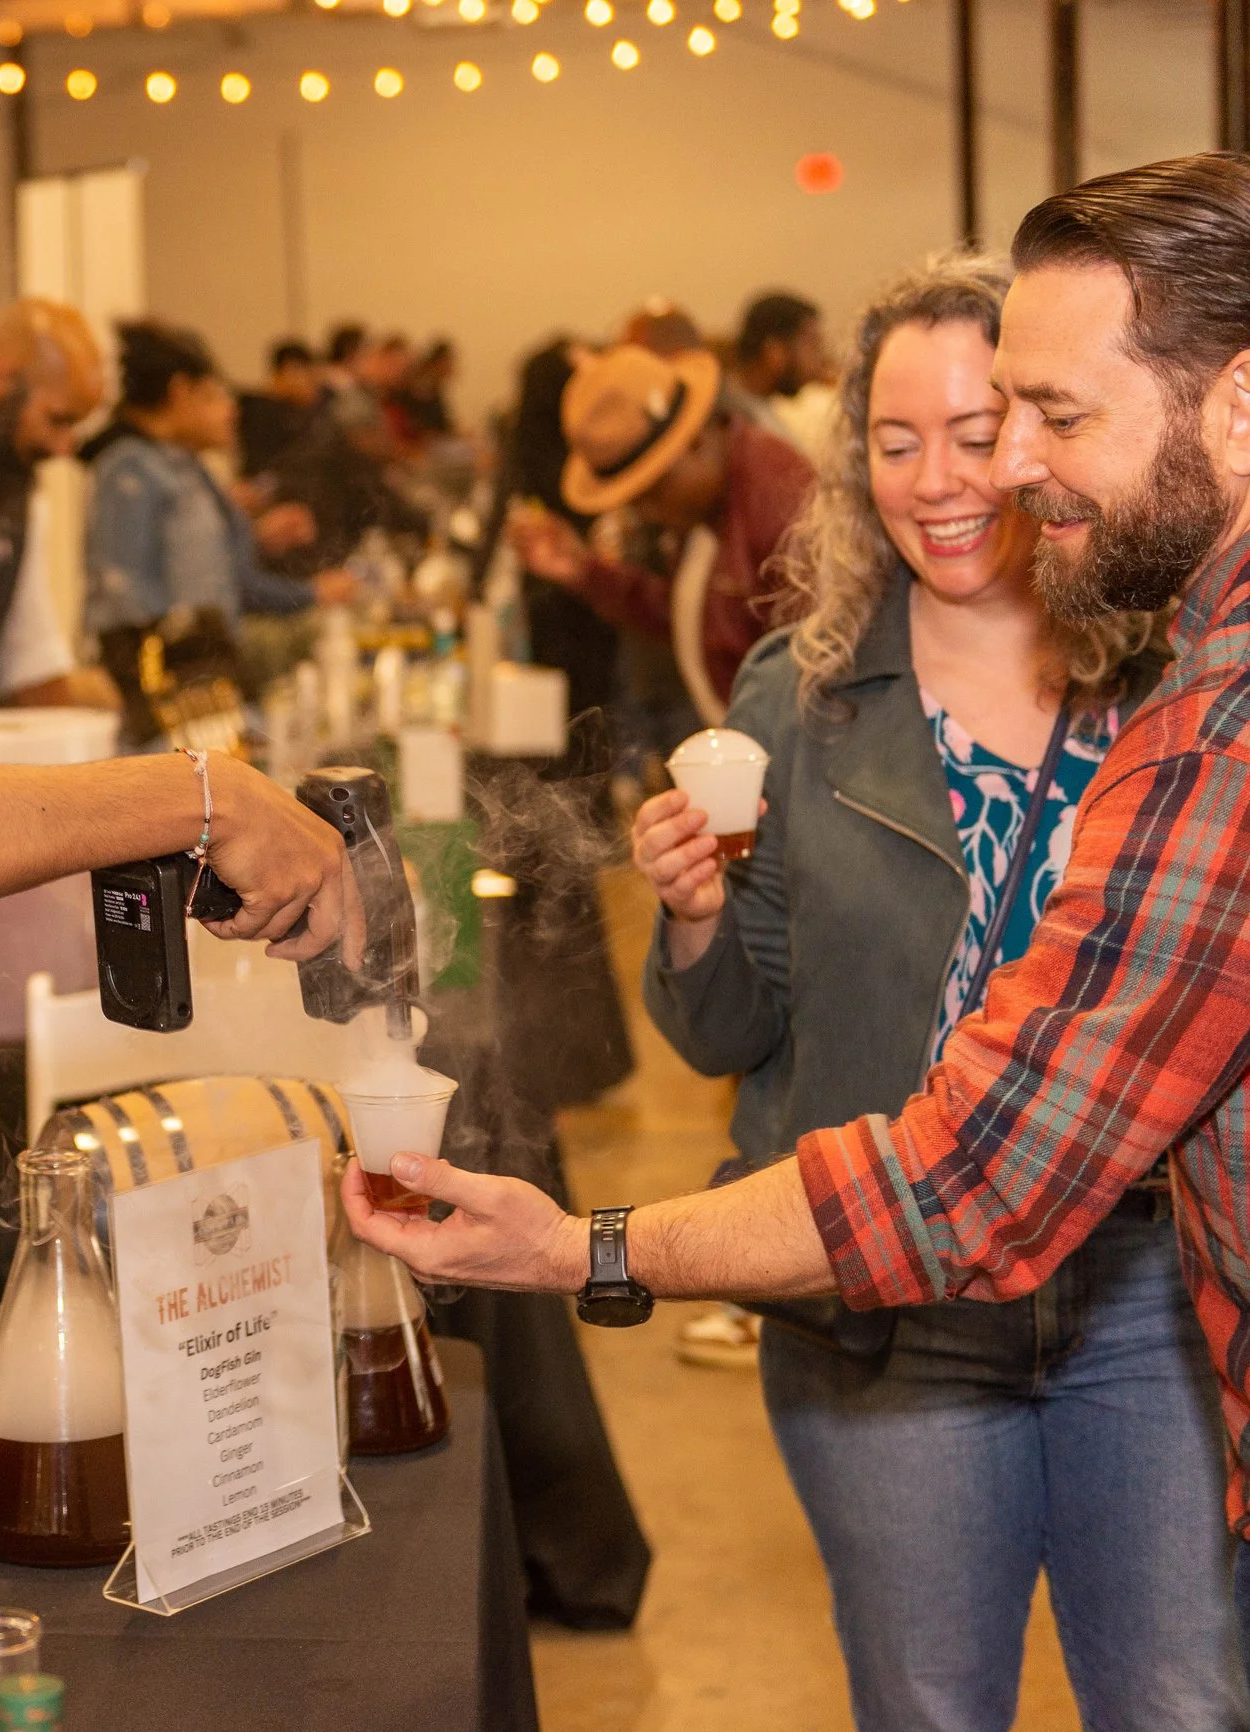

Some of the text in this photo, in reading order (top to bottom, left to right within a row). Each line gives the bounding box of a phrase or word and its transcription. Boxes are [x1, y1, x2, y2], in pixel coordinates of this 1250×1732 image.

[156, 1253, 292, 1325] THE ALCHEMIST
[226, 1322, 242, 1342] of
[201, 1350, 261, 1381] DogFish Gin
[203, 1372, 262, 1402] Elderflower
[208, 1395, 259, 1423] Dandelion
[207, 1416, 263, 1445] Cardamom
[220, 1442, 253, 1463] Ginger
[212, 1460, 264, 1488] Cinnamon
[222, 1485, 258, 1507] Lemon
[242, 1506, 259, 1521] END
[270, 1488, 304, 1508] MINUTES
[171, 1541, 194, 1558] PRIOR
[195, 1536, 206, 1548] TO
[206, 1529, 223, 1543] THE
[224, 1523, 241, 1537] END
[241, 1518, 253, 1530] OF
[253, 1511, 271, 1525] THE
